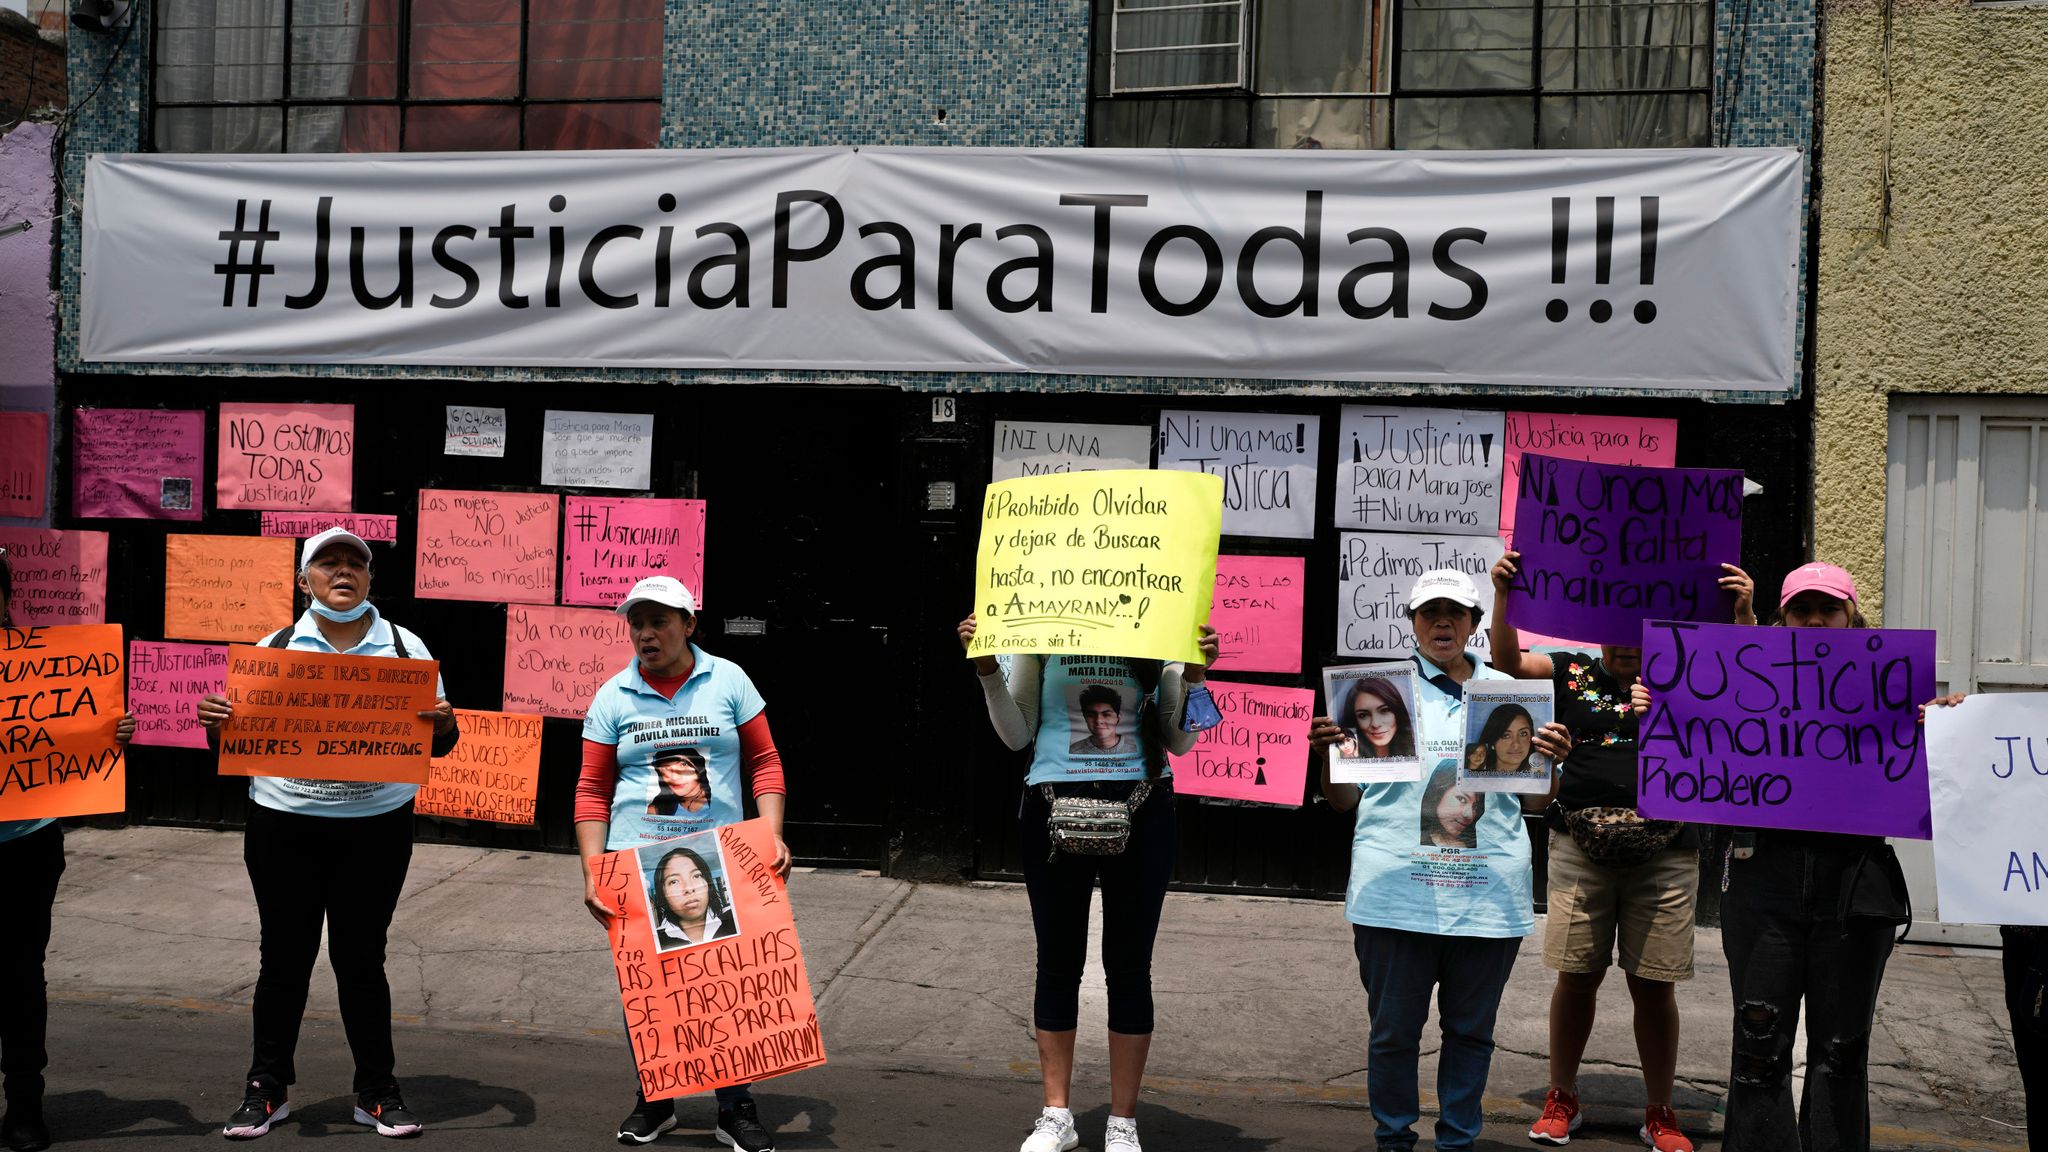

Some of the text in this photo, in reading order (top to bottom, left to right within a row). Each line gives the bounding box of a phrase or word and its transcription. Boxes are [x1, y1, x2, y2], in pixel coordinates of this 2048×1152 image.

[214, 190, 1660, 324] #JusticiaParaTodas !!!
[934, 399, 954, 418] 18
[230, 418, 265, 451] NO
[274, 424, 351, 456] estamos
[1047, 432, 1100, 457] UNA
[1211, 425, 1253, 453] una
[1257, 423, 1305, 454] Mas!
[1590, 427, 1660, 452] para las
[242, 452, 323, 483] TODAS
[237, 483, 317, 506] Justicia!!
[1353, 465, 1401, 495] para
[1459, 479, 1493, 505] Jose
[1520, 453, 1560, 506] Ni
[1576, 468, 1668, 516] Una
[1681, 473, 1744, 520] Mas
[421, 491, 499, 520] Las mujeres
[515, 501, 550, 526] Justicia
[986, 490, 1079, 519] ¡Prohibido
[1352, 494, 1478, 526] #Ni Una mas
[358, 519, 397, 539] JOSE
[474, 513, 505, 536] NO
[32, 535, 61, 558] José
[448, 529, 493, 548] tocan
[994, 524, 1161, 556] y dejar de Buscar
[1540, 509, 1708, 567] nos falta
[421, 552, 468, 568] Menos
[516, 546, 554, 563] Justicia
[1340, 538, 1423, 581] ¡Pedimos
[52, 569, 66, 581] en
[419, 574, 450, 590] Justicia
[464, 565, 551, 590] las niñas!!!
[1051, 568, 1075, 587] no
[1081, 563, 1184, 593] encontrar
[1508, 549, 1699, 621] Amairany
[986, 603, 999, 616] a
[4, 625, 50, 651] DE
[516, 609, 573, 642] Ya no
[1345, 623, 1384, 651] Cada
[1001, 634, 1037, 648] años
[1047, 633, 1064, 648] sin
[232, 659, 430, 685] MARIA JOSE IRAS DIRECTO
[518, 649, 605, 675] ¿Donde está
[1060, 655, 1106, 665] ROBERTO
[1645, 621, 1914, 715] Justicia
[551, 676, 565, 693] la
[1068, 667, 1136, 679] MATA FLORES
[170, 682, 183, 693] NI
[247, 689, 283, 706] CIELO
[286, 692, 330, 708] MEJOR
[176, 700, 190, 713] LA
[1239, 691, 1310, 722] Feminicidios
[284, 718, 321, 733] PARA
[326, 720, 412, 736] ENCONTRAR
[502, 716, 541, 739] TODAS
[627, 716, 709, 734] ANDREA MICHAEL
[634, 726, 720, 744] DÁVILA MARTÍNEZ
[222, 738, 423, 756] MUJERES DESAPARECIDAS
[1256, 731, 1292, 756] para
[1638, 700, 1919, 783] Amairany
[471, 745, 508, 766] VOCES
[486, 770, 528, 792] DESDE
[1641, 755, 1793, 807] Roblero
[420, 785, 487, 808] TUMBA NO
[720, 827, 779, 906] AMAIRANY
[617, 928, 797, 994] LAS FISCALIAS
[626, 963, 798, 1028] SE TARDARON
[634, 997, 796, 1066] 12 AÑOS PARA
